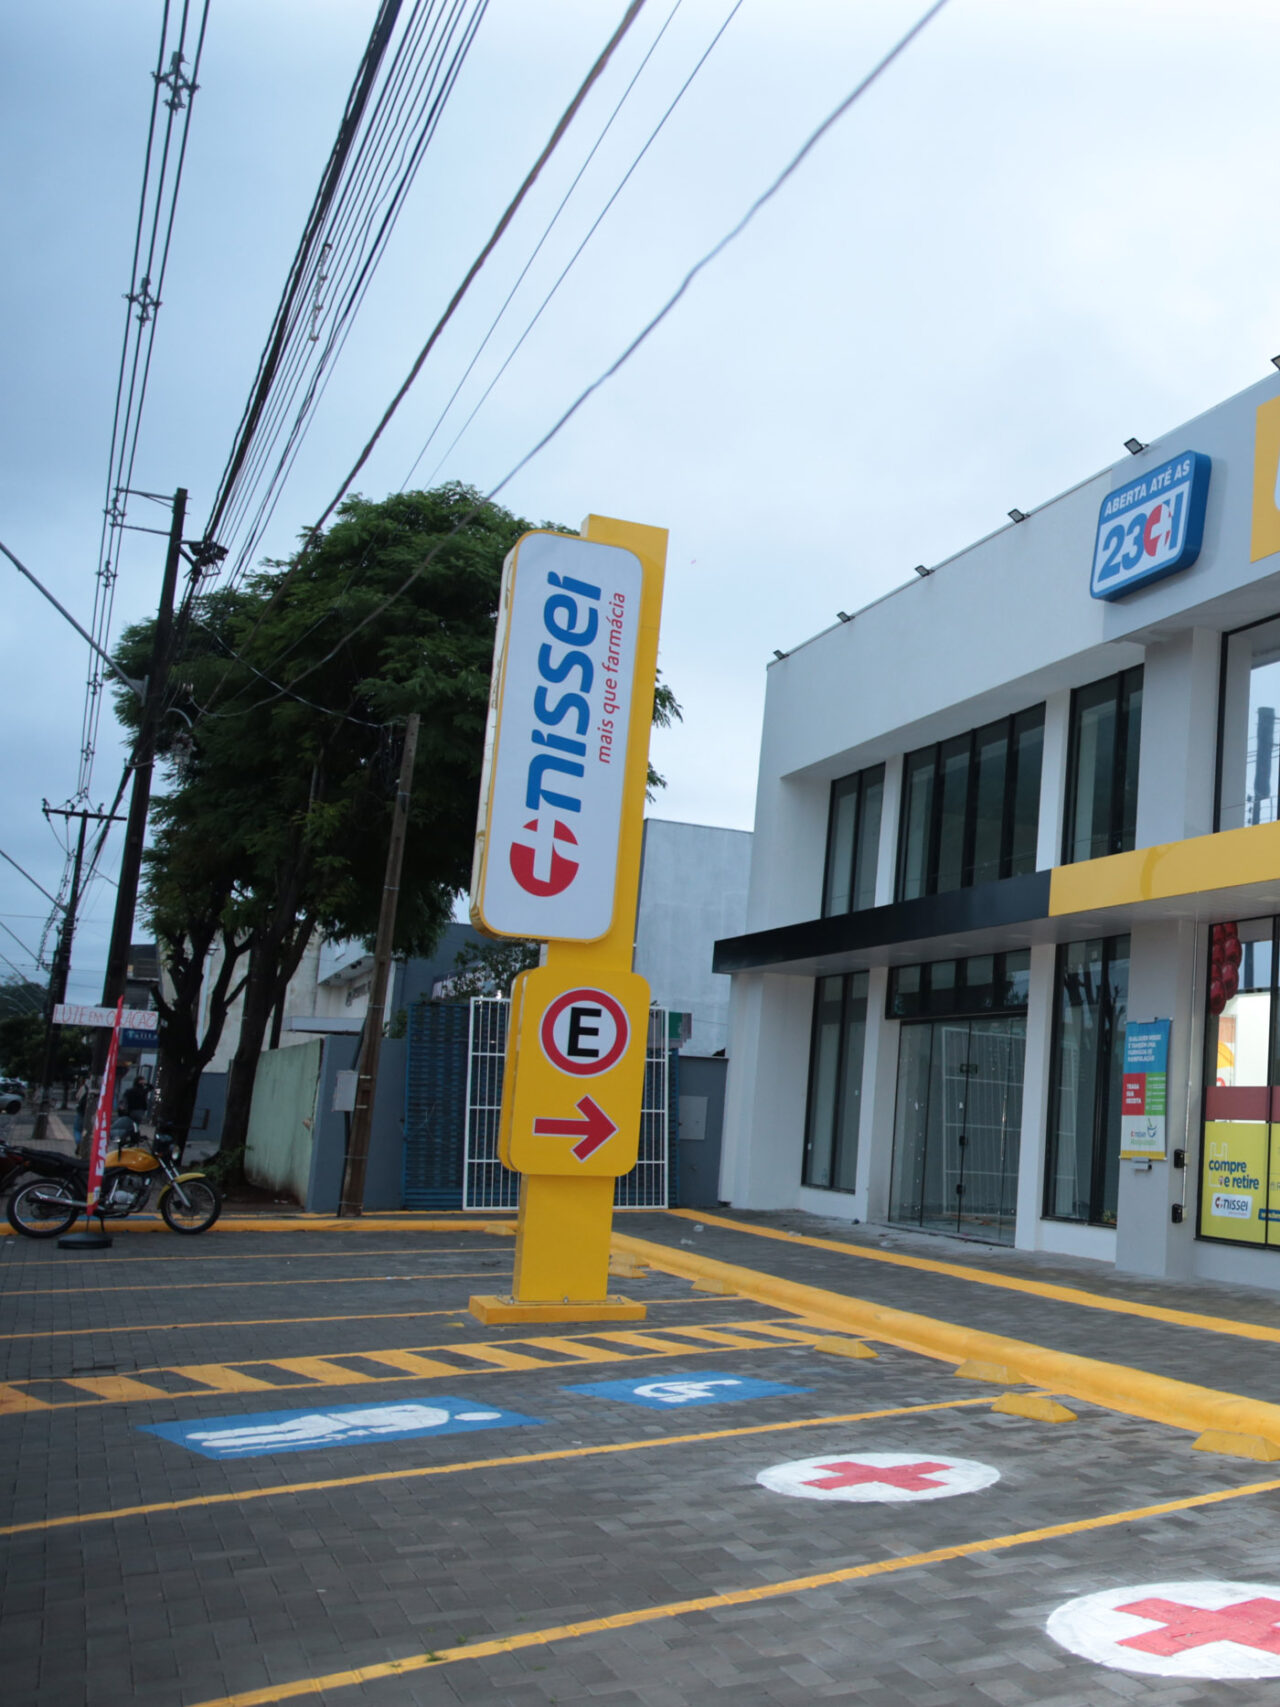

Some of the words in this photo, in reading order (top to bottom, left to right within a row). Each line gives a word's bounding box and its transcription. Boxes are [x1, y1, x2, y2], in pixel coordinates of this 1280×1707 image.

[1104, 483, 1147, 517] ABERTA
[1150, 466, 1172, 494] ATÉ
[1174, 459, 1191, 481] AS
[602, 592, 626, 673] farmácia
[525, 570, 602, 813] nissei
[603, 674, 620, 714] que
[599, 720, 614, 764] mais
[54, 1004, 88, 1023] LUTE
[567, 1007, 602, 1058] E
[1208, 1160, 1247, 1174] compre
[1223, 1177, 1230, 1188] e
[1232, 1174, 1260, 1190] retire
[1223, 1197, 1249, 1212] nissei
